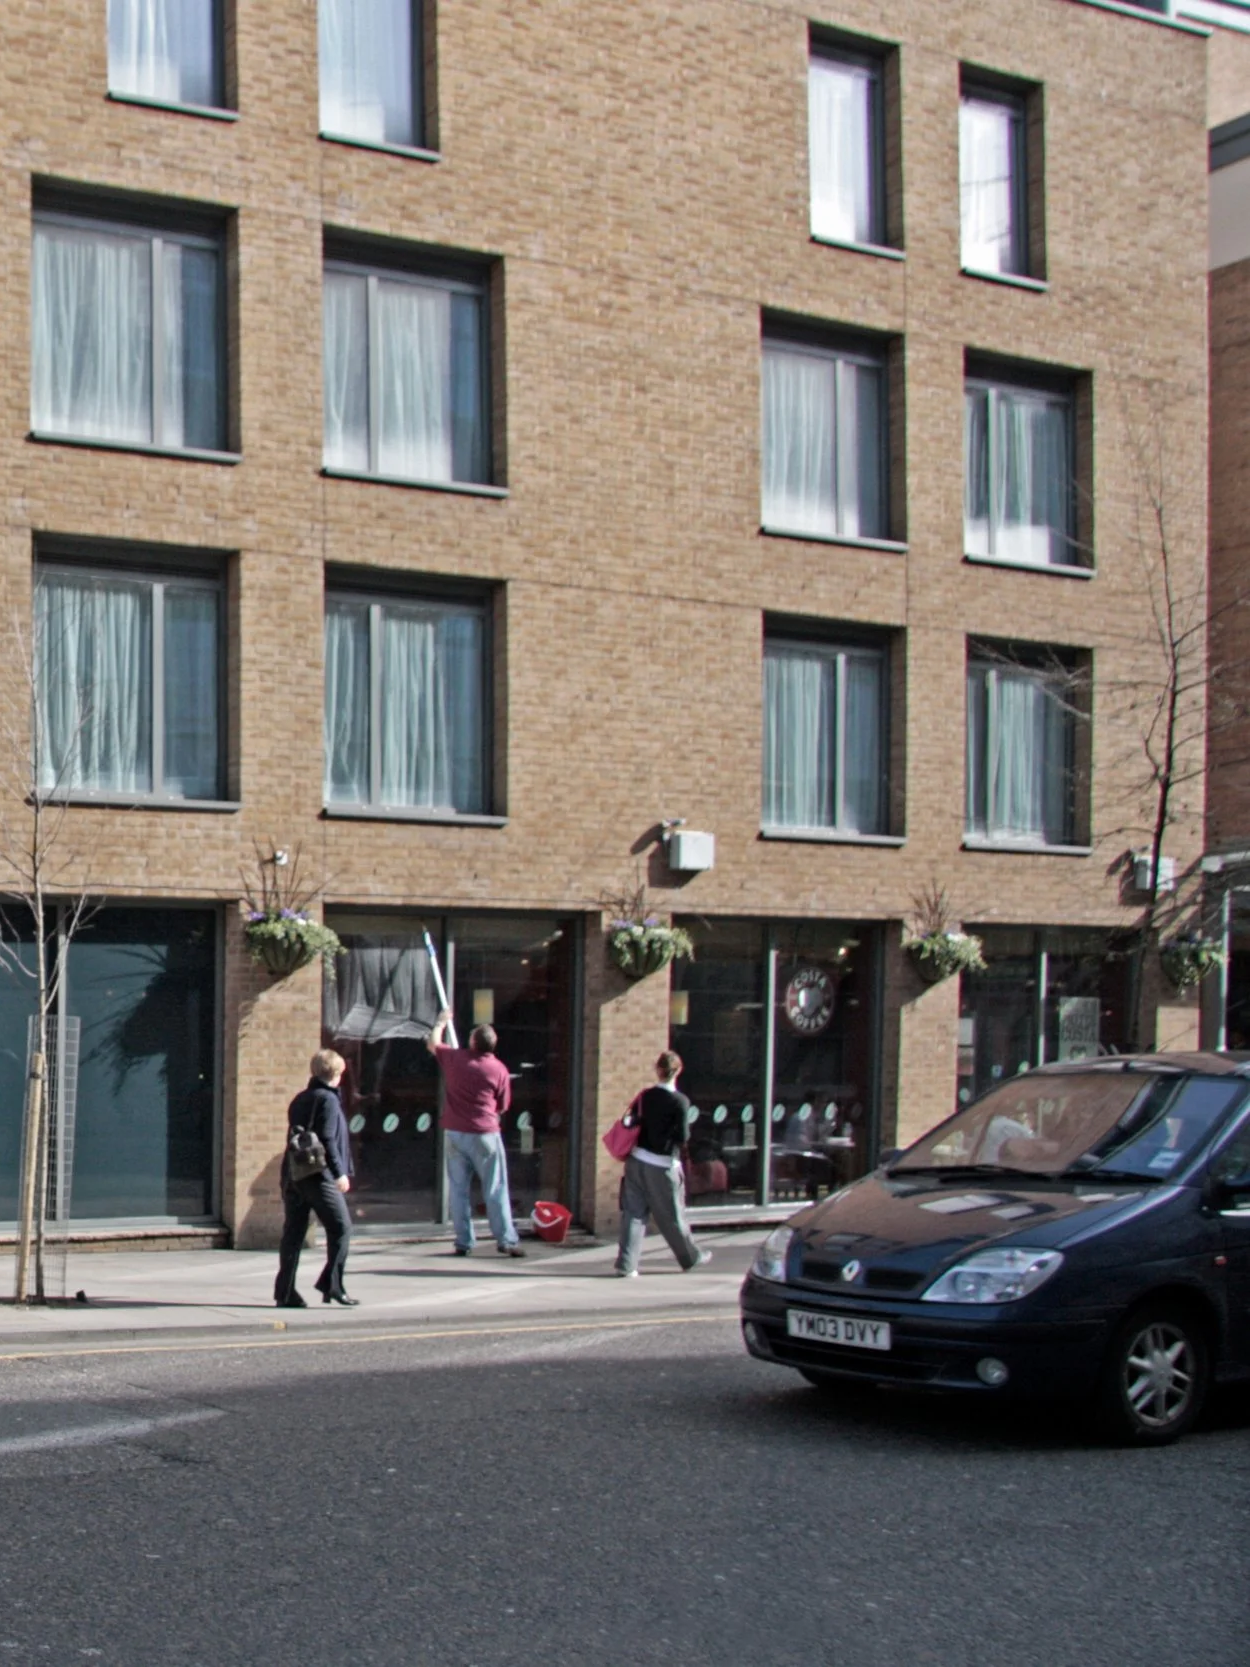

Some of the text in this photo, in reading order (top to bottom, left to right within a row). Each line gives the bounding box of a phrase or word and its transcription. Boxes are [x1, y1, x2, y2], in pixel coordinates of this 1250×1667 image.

[793, 969, 827, 989] COSTA
[790, 1005, 830, 1029] COFFEE
[795, 1313, 881, 1344] YM03 DVY
